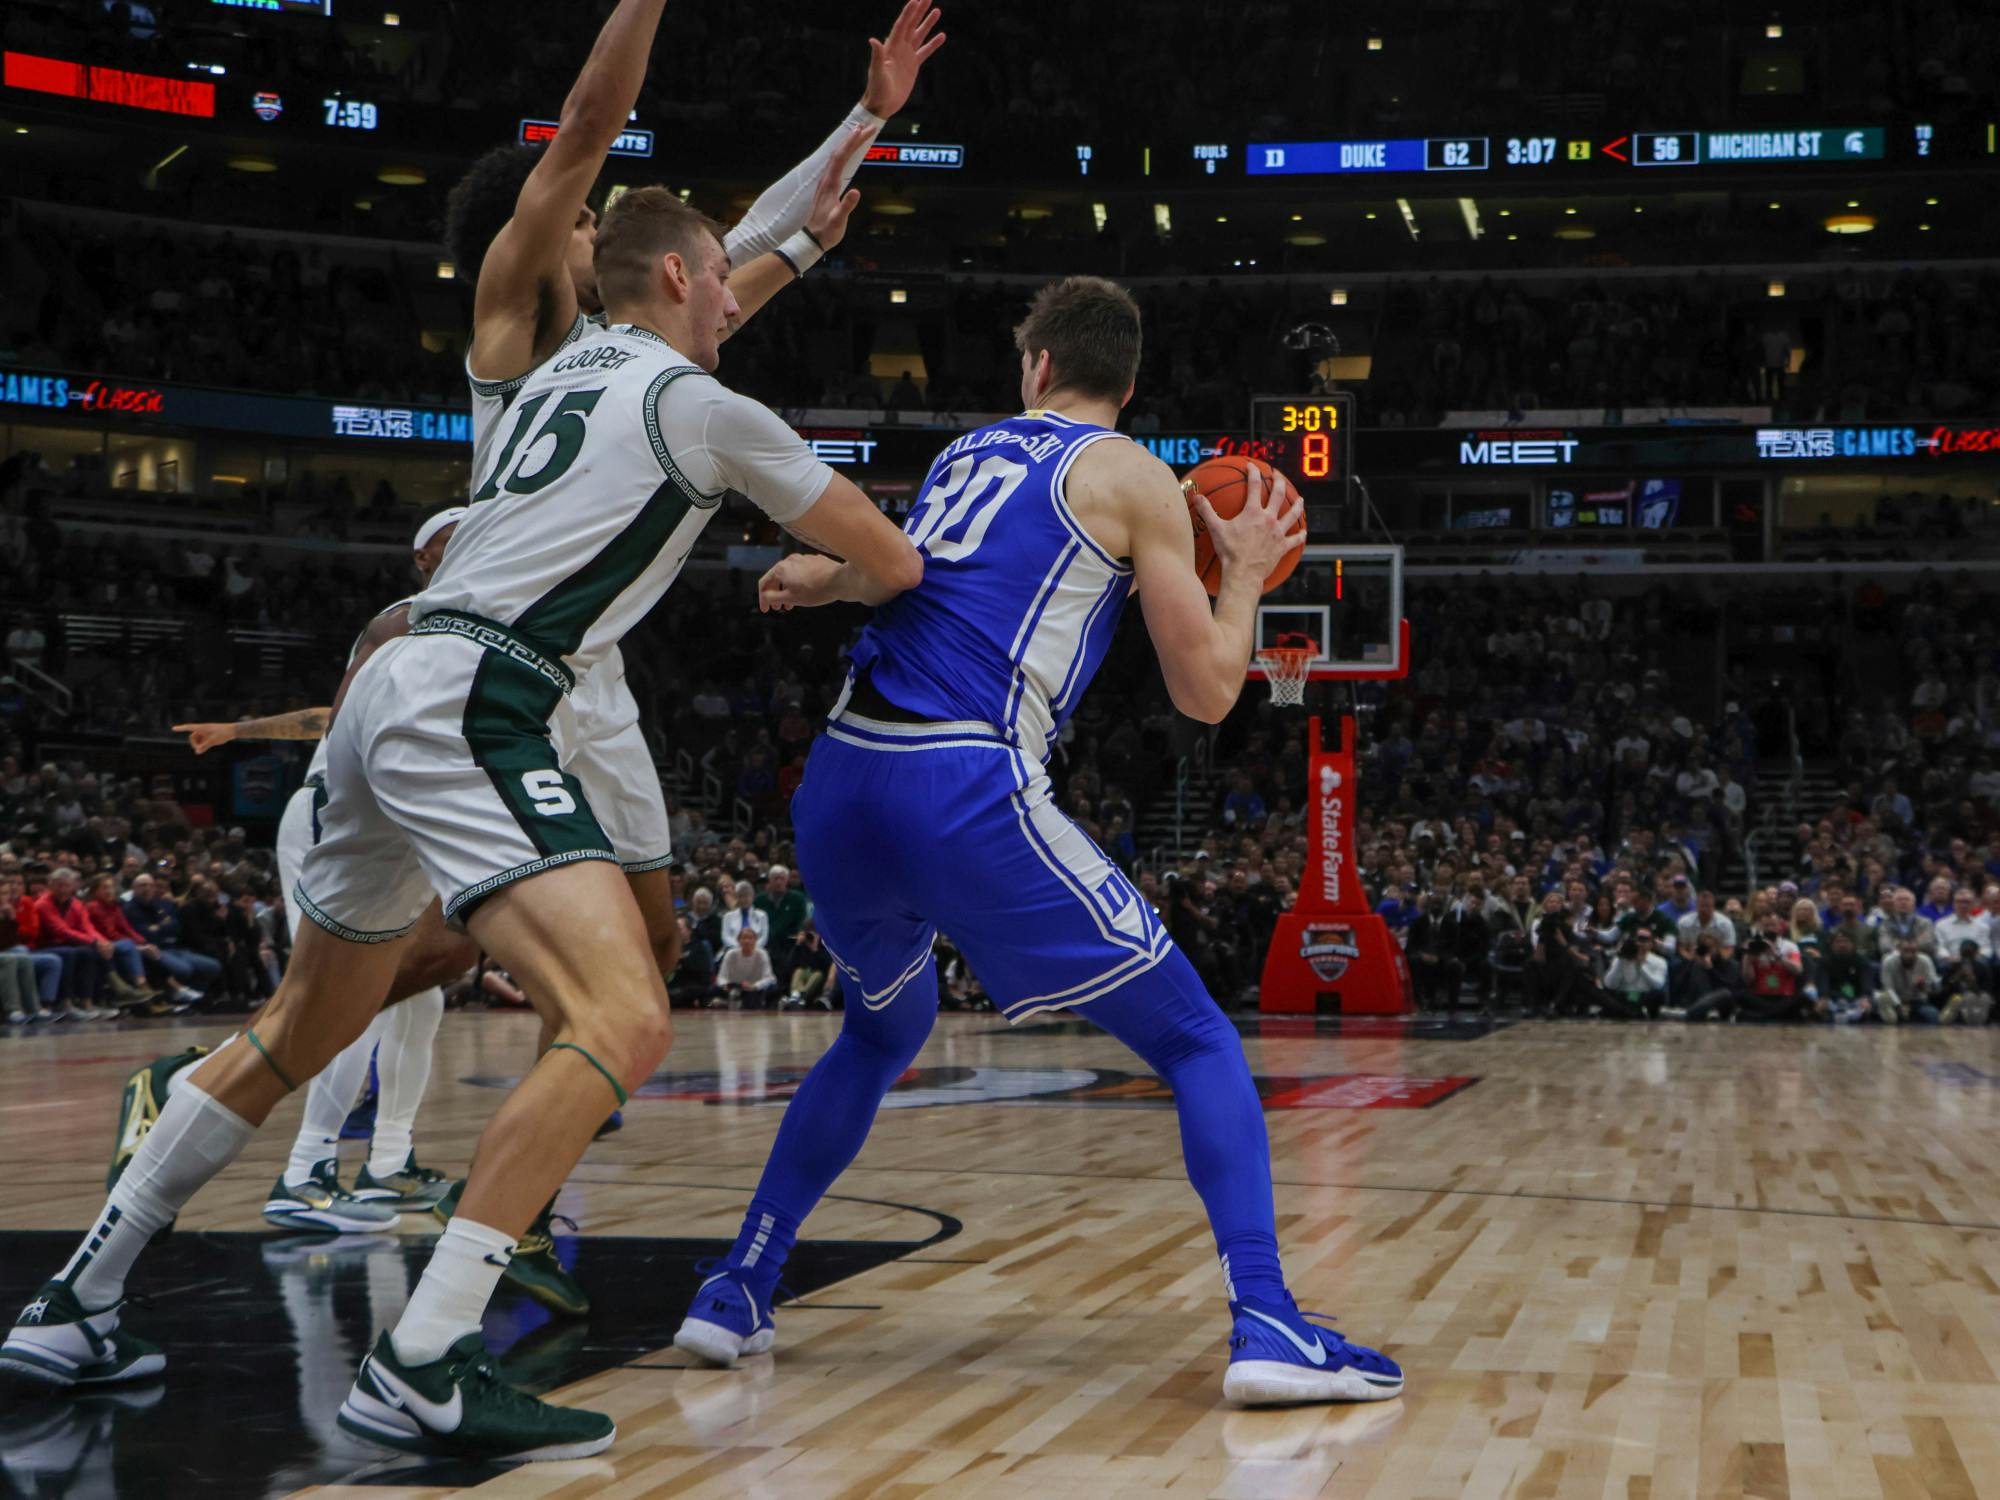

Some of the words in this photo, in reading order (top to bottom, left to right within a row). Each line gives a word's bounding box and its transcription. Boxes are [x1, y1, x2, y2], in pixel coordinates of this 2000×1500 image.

[324, 99, 377, 129] 7:59
[611, 134, 648, 151] NTS
[1077, 146, 1092, 160] TO
[1194, 145, 1228, 159] FOULS
[1340, 144, 1386, 168] DUKE
[1443, 142, 1470, 166] 62
[1506, 138, 1556, 165] 3:07
[1653, 137, 1680, 162] 56
[1708, 132, 1796, 160] MICHIGAN
[1797, 131, 1822, 158] ST
[864, 147, 898, 161] SPN
[899, 148, 958, 163] EVENTS
[1081, 160, 1088, 175] 1
[333, 417, 413, 438] TEAMS
[421, 412, 474, 442] GAM
[1283, 406, 1337, 431] 3:07
[472, 386, 608, 502] 15
[806, 440, 877, 463] ET
[1460, 441, 1579, 464] MEET
[1757, 440, 1834, 458] TEAMS
[1843, 428, 1915, 456] GAMES
[1303, 433, 1329, 477] 8
[904, 453, 1028, 563] 30
[521, 769, 577, 816] S
